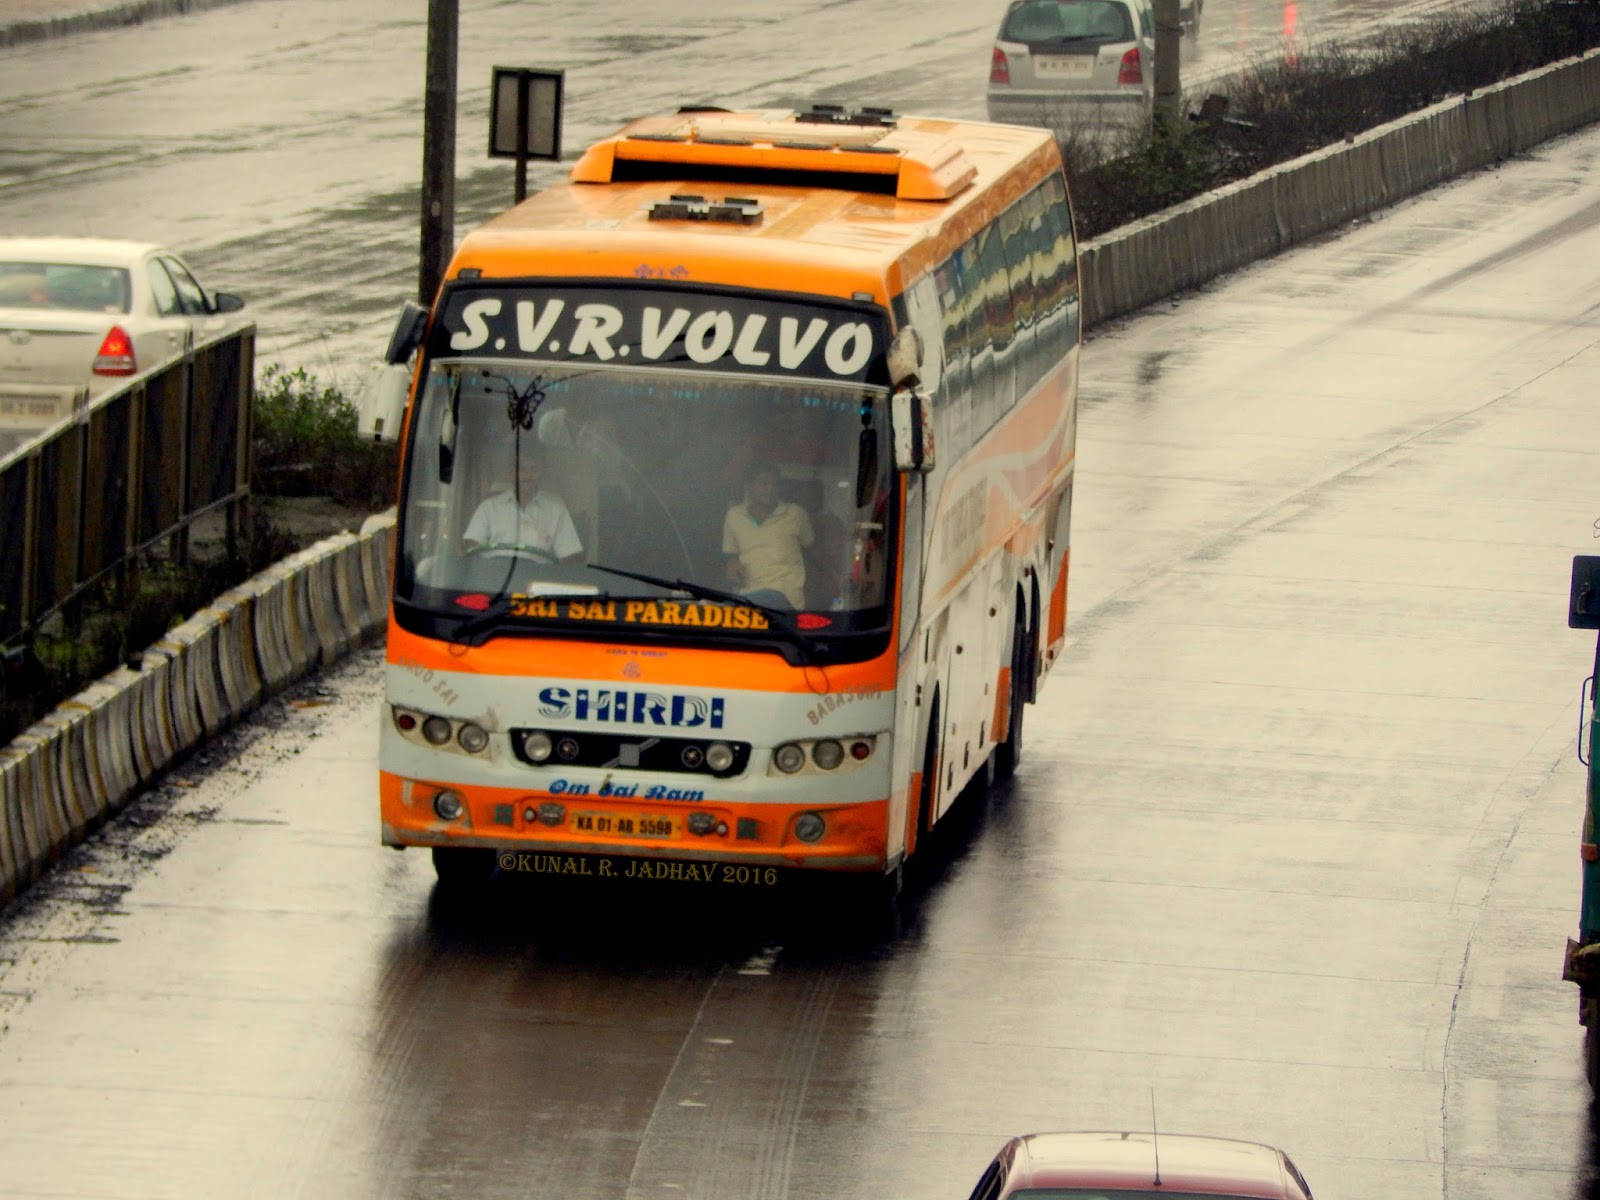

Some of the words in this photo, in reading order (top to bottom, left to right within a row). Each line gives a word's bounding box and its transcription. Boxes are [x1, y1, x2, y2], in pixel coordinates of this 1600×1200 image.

[568, 600, 617, 622] SAI
[624, 600, 769, 630] PARADISE
[538, 686, 725, 729] SHIRDI
[549, 779, 590, 796] Om
[599, 781, 639, 798] Sai
[645, 785, 705, 802] Ram
[577, 815, 593, 830] KA
[597, 816, 612, 832] 01
[618, 818, 634, 834] AB
[640, 818, 672, 836] 5598
